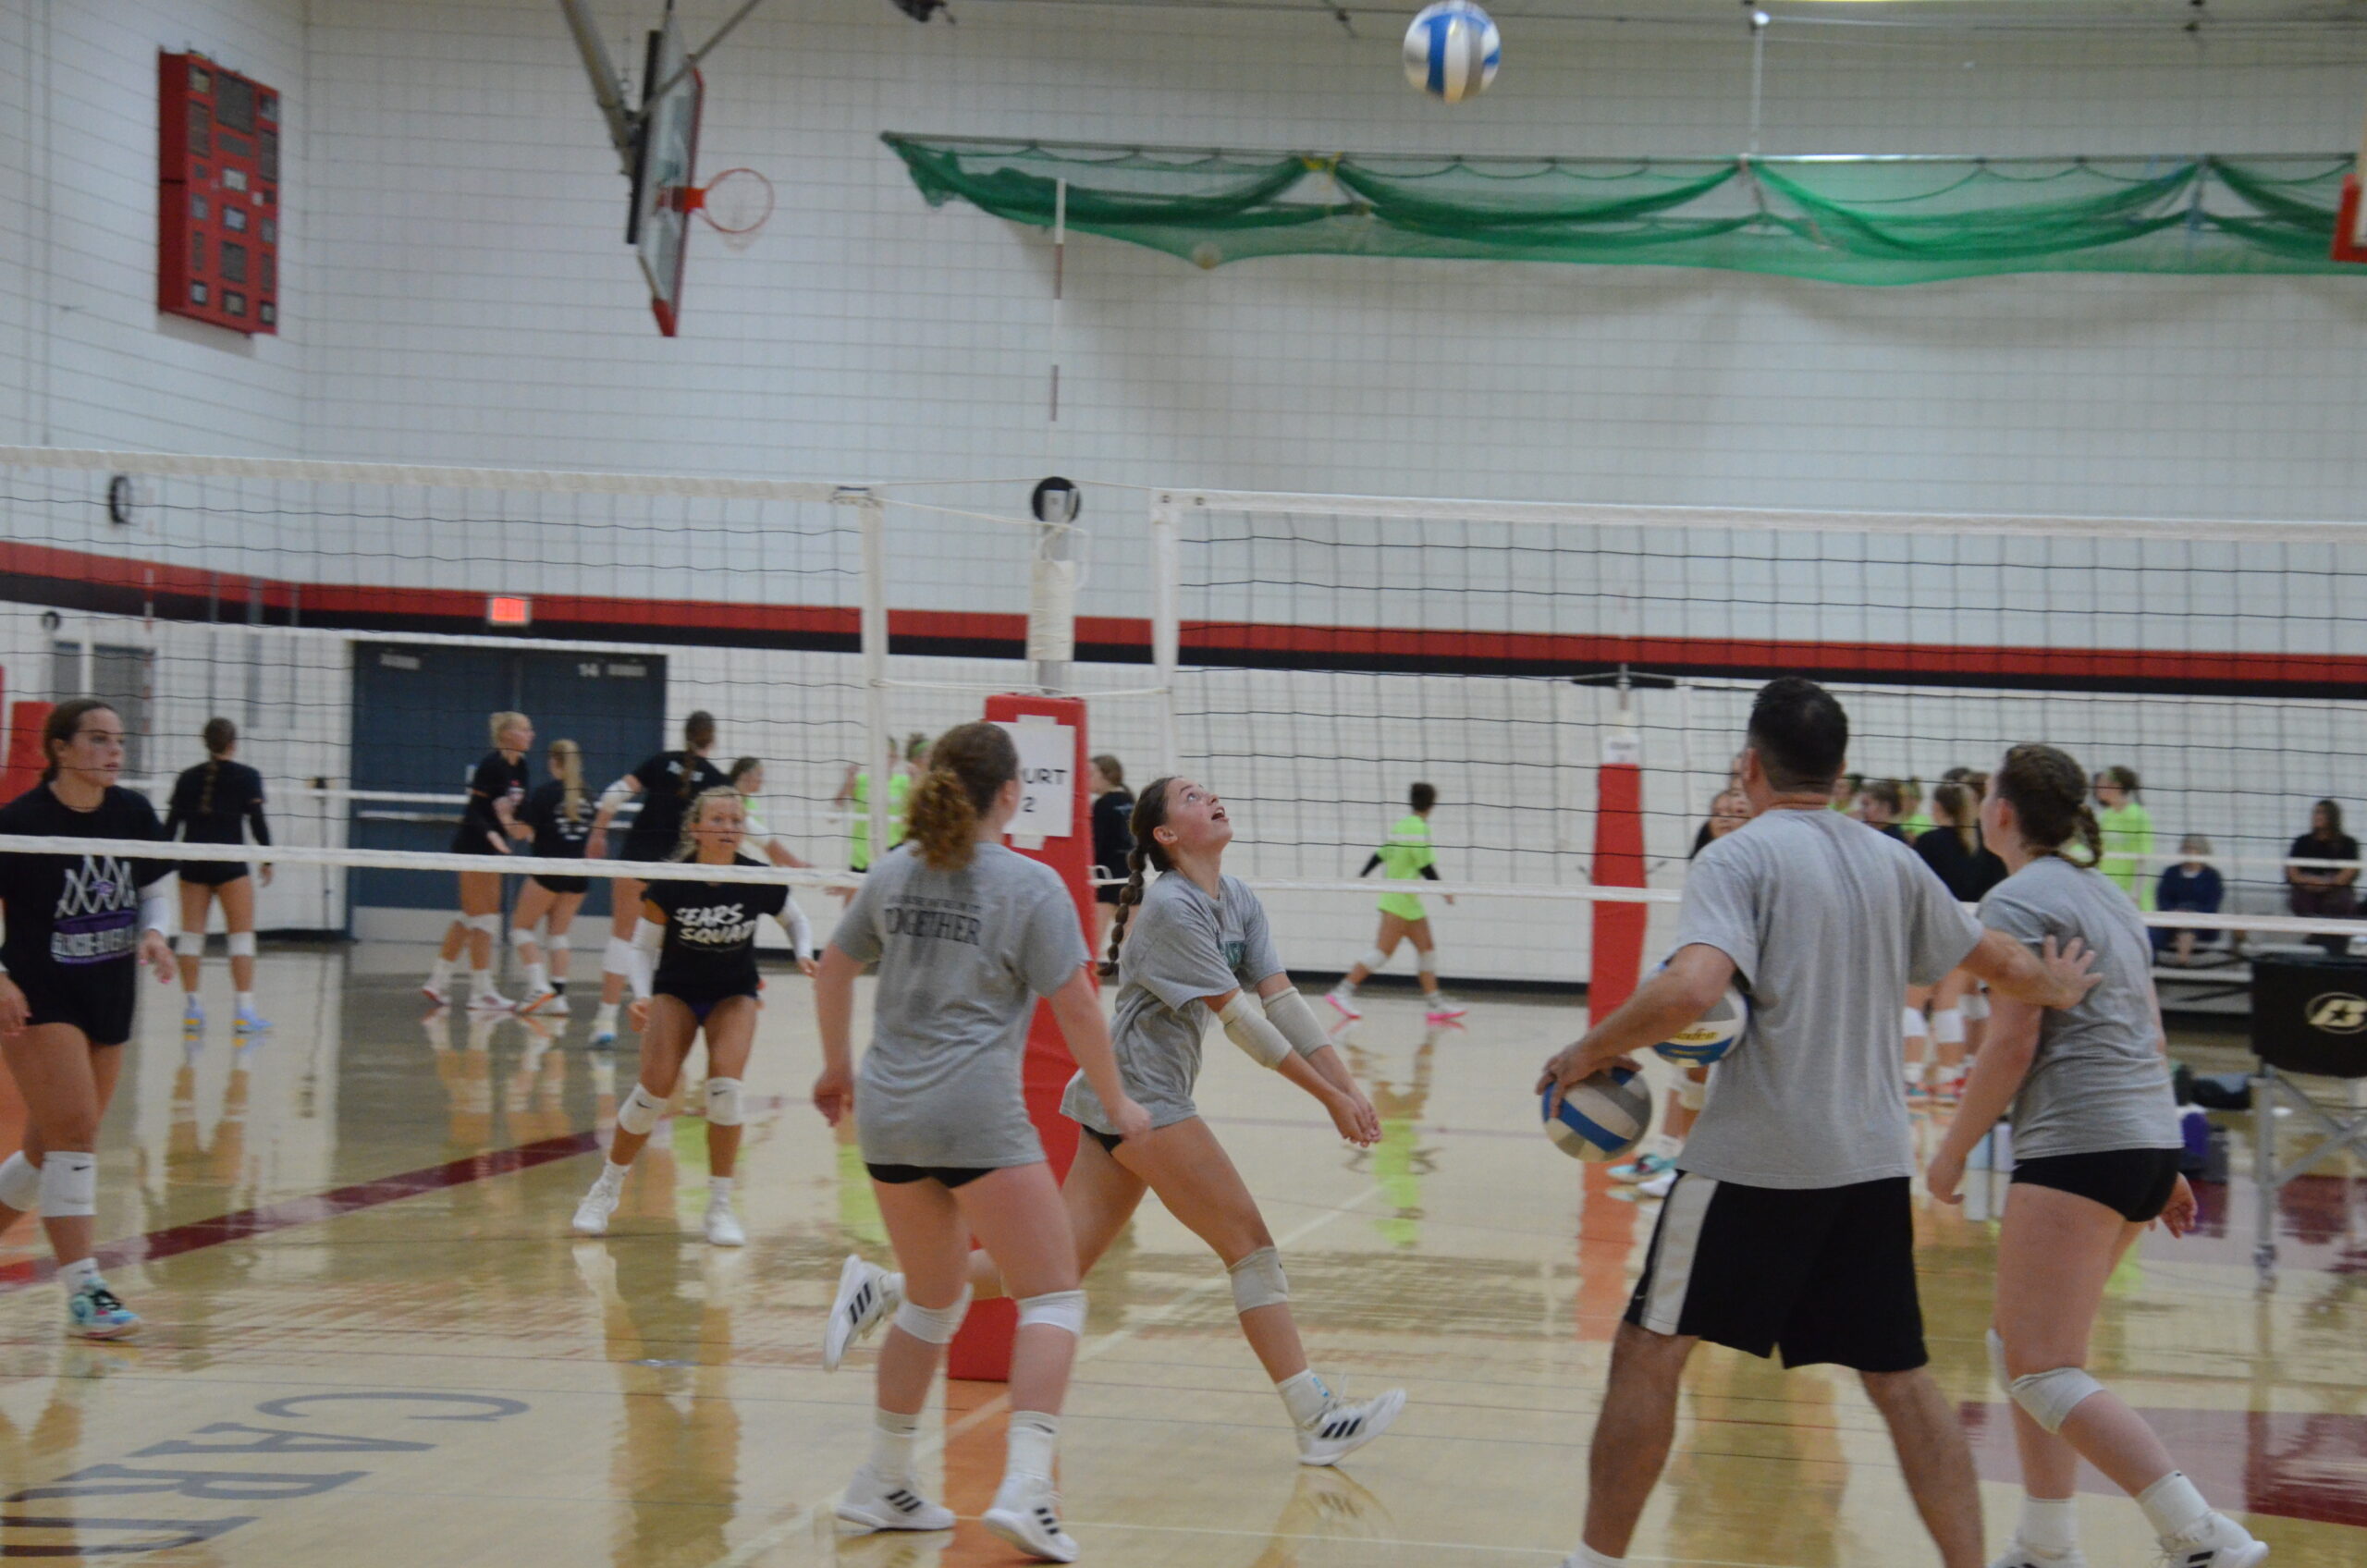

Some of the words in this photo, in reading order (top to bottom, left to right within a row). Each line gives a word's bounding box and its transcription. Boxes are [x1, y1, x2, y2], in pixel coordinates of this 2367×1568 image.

[1021, 767, 1069, 785] URT
[1022, 796, 1036, 813] 2
[674, 902, 744, 927] SEARS
[679, 920, 756, 945] SQUAD
